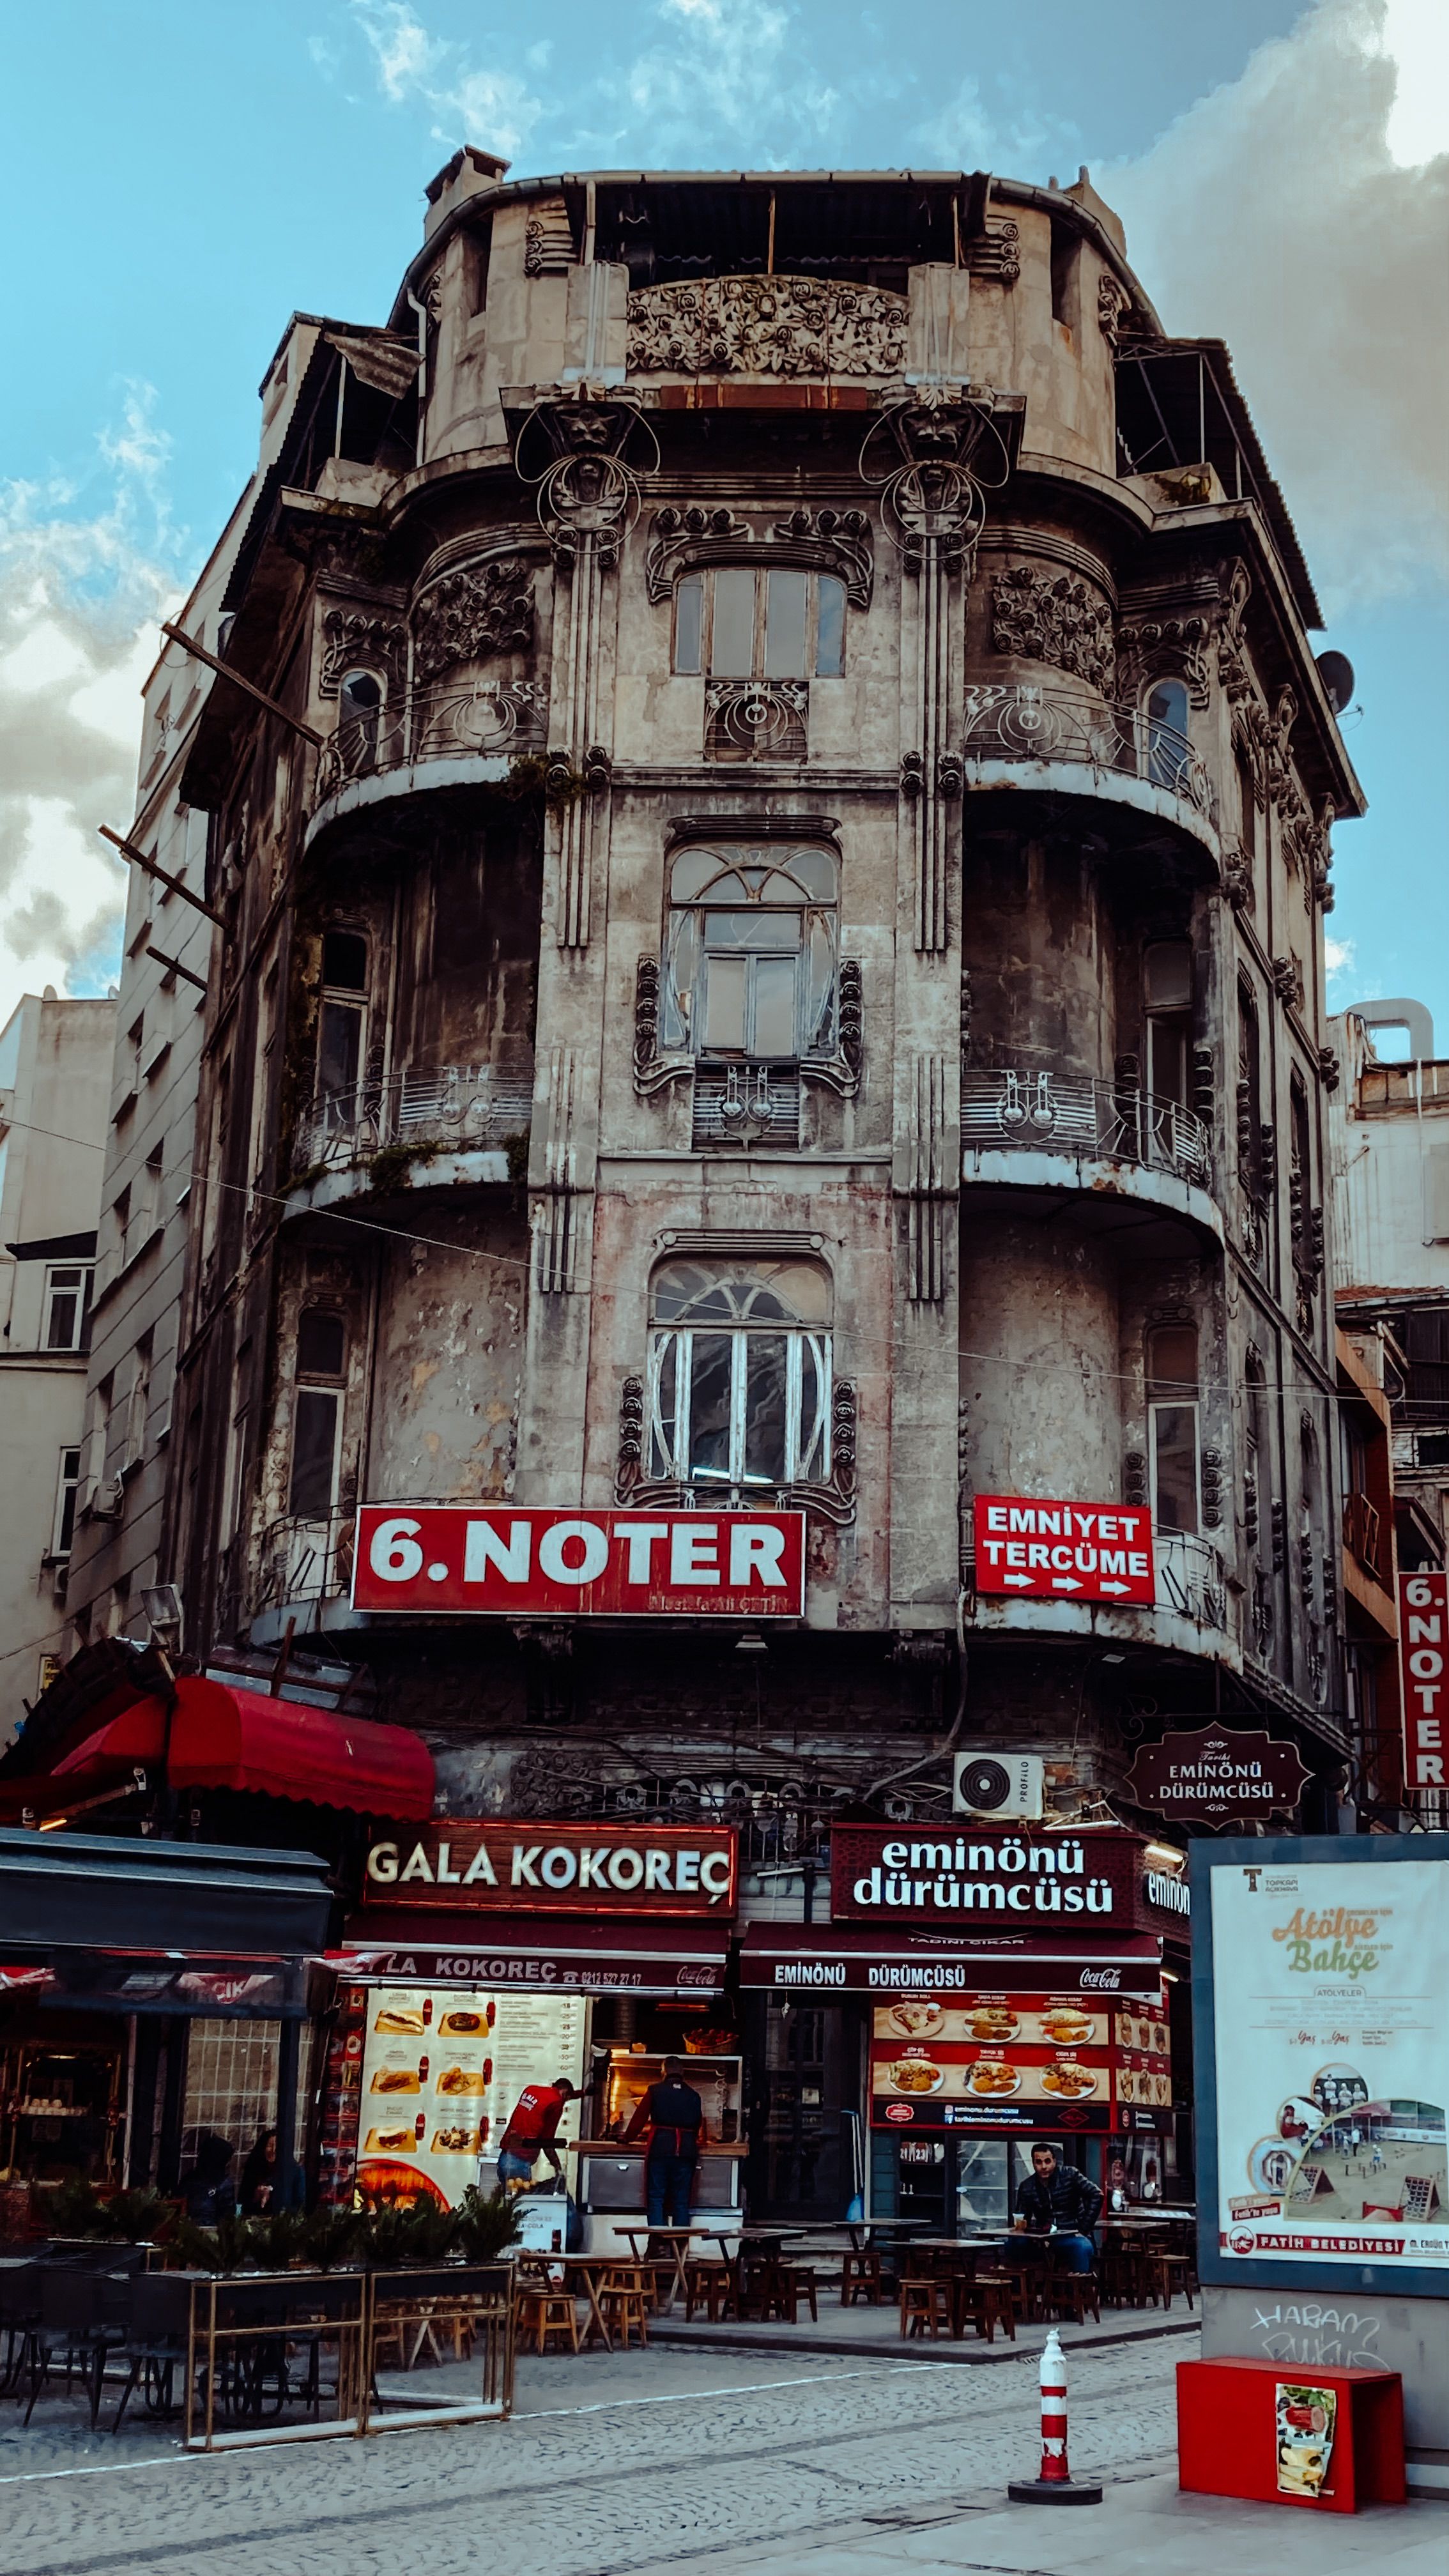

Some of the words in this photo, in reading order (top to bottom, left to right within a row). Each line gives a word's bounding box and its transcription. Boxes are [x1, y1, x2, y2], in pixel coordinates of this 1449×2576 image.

[988, 1505, 1140, 1542] EMNİYET
[369, 1518, 449, 1583] 6.
[463, 1519, 788, 1587] NOTER
[983, 1539, 1149, 1577] TERCÜME
[1406, 1578, 1445, 1607] 6.
[1408, 1614, 1446, 1784] NOTER
[1169, 1761, 1262, 1779] EMİNÖNÜ
[1159, 1781, 1274, 1799] DÜRÜMCÜSÜ
[367, 1841, 499, 1885] GALA
[510, 1844, 732, 1905] KOKOREÇ
[882, 1837, 1084, 1874] eminönü
[853, 1867, 1113, 1913] dürümcüsü
[435, 1957, 557, 1984] KOKOREÇ
[774, 1961, 847, 1984] EMİNÖNÜ
[868, 1964, 966, 1988] DÜRÜMCÜSÜ
[1286, 1940, 1379, 1980] Bahçe
[1261, 2234, 1305, 2249] FATİH
[1310, 2236, 1400, 2253] BELEDİYESİ
